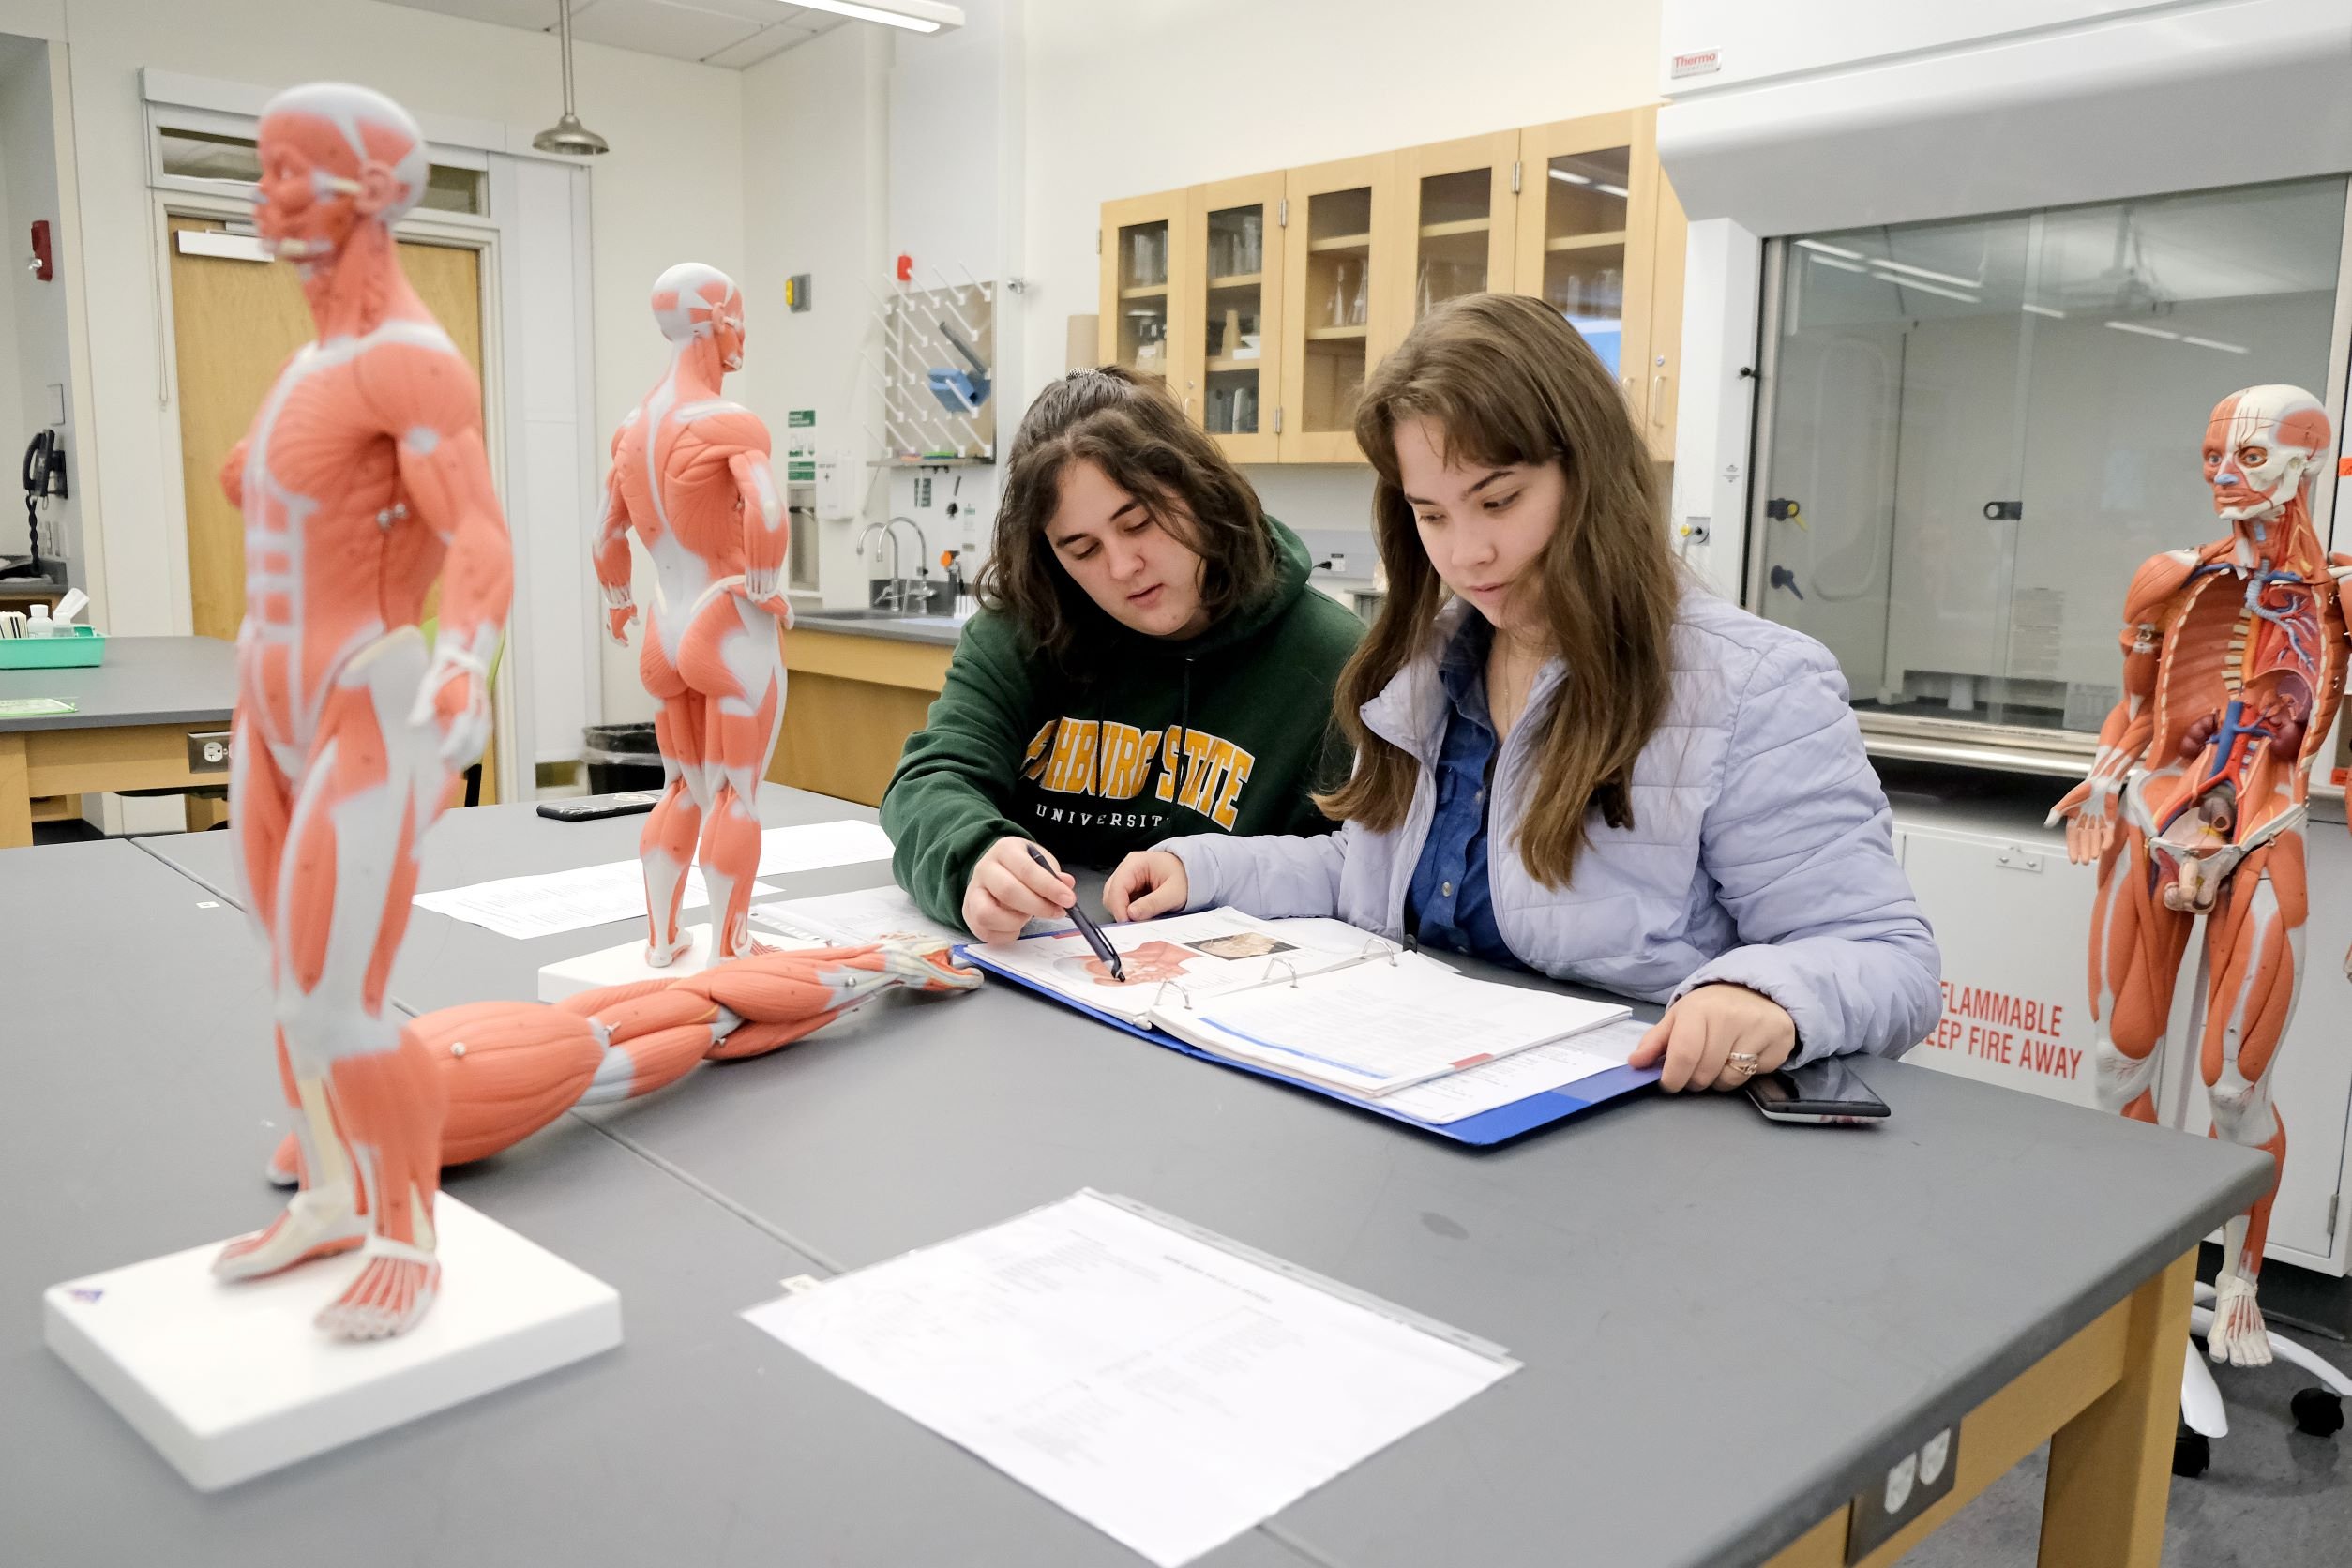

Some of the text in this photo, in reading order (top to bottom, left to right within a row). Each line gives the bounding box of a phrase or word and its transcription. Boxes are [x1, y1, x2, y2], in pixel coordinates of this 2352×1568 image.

[1673, 53, 1716, 68] Thermo
[1036, 803, 1169, 828] UNIVERSIT
[1968, 1026, 2013, 1064] FIRE
[2019, 1038, 2083, 1080] AWAY
